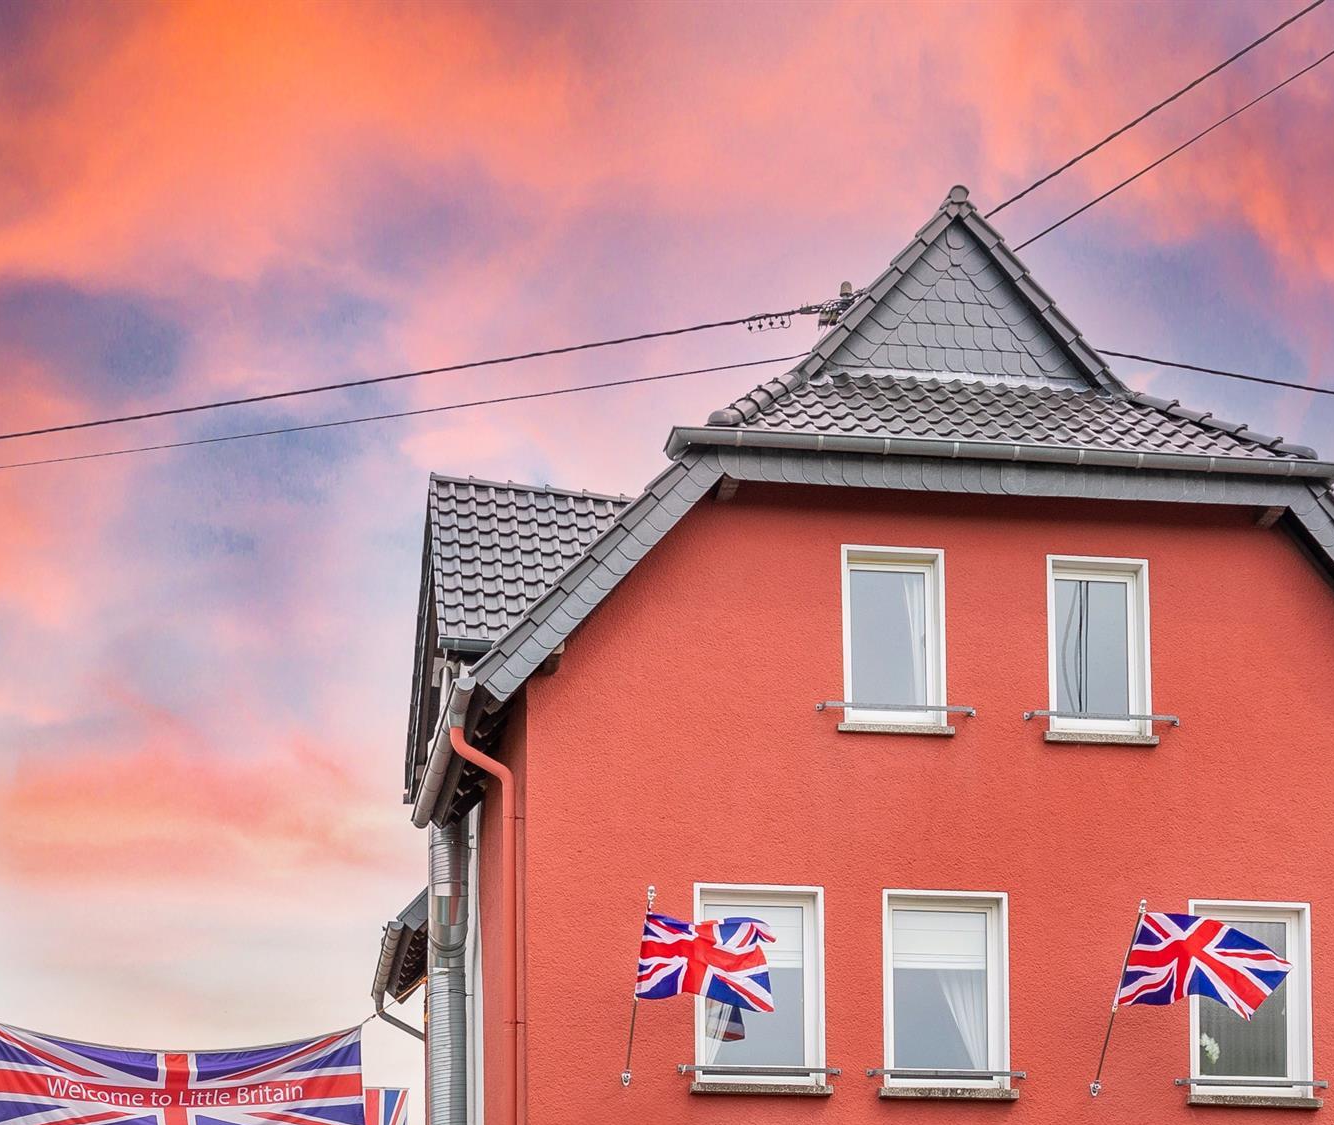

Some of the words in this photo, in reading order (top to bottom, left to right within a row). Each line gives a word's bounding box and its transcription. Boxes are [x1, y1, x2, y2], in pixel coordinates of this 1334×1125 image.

[47, 1077, 143, 1106] Welcome
[150, 1094, 172, 1106] to
[178, 1092, 230, 1106] Little
[236, 1084, 304, 1104] Britain
